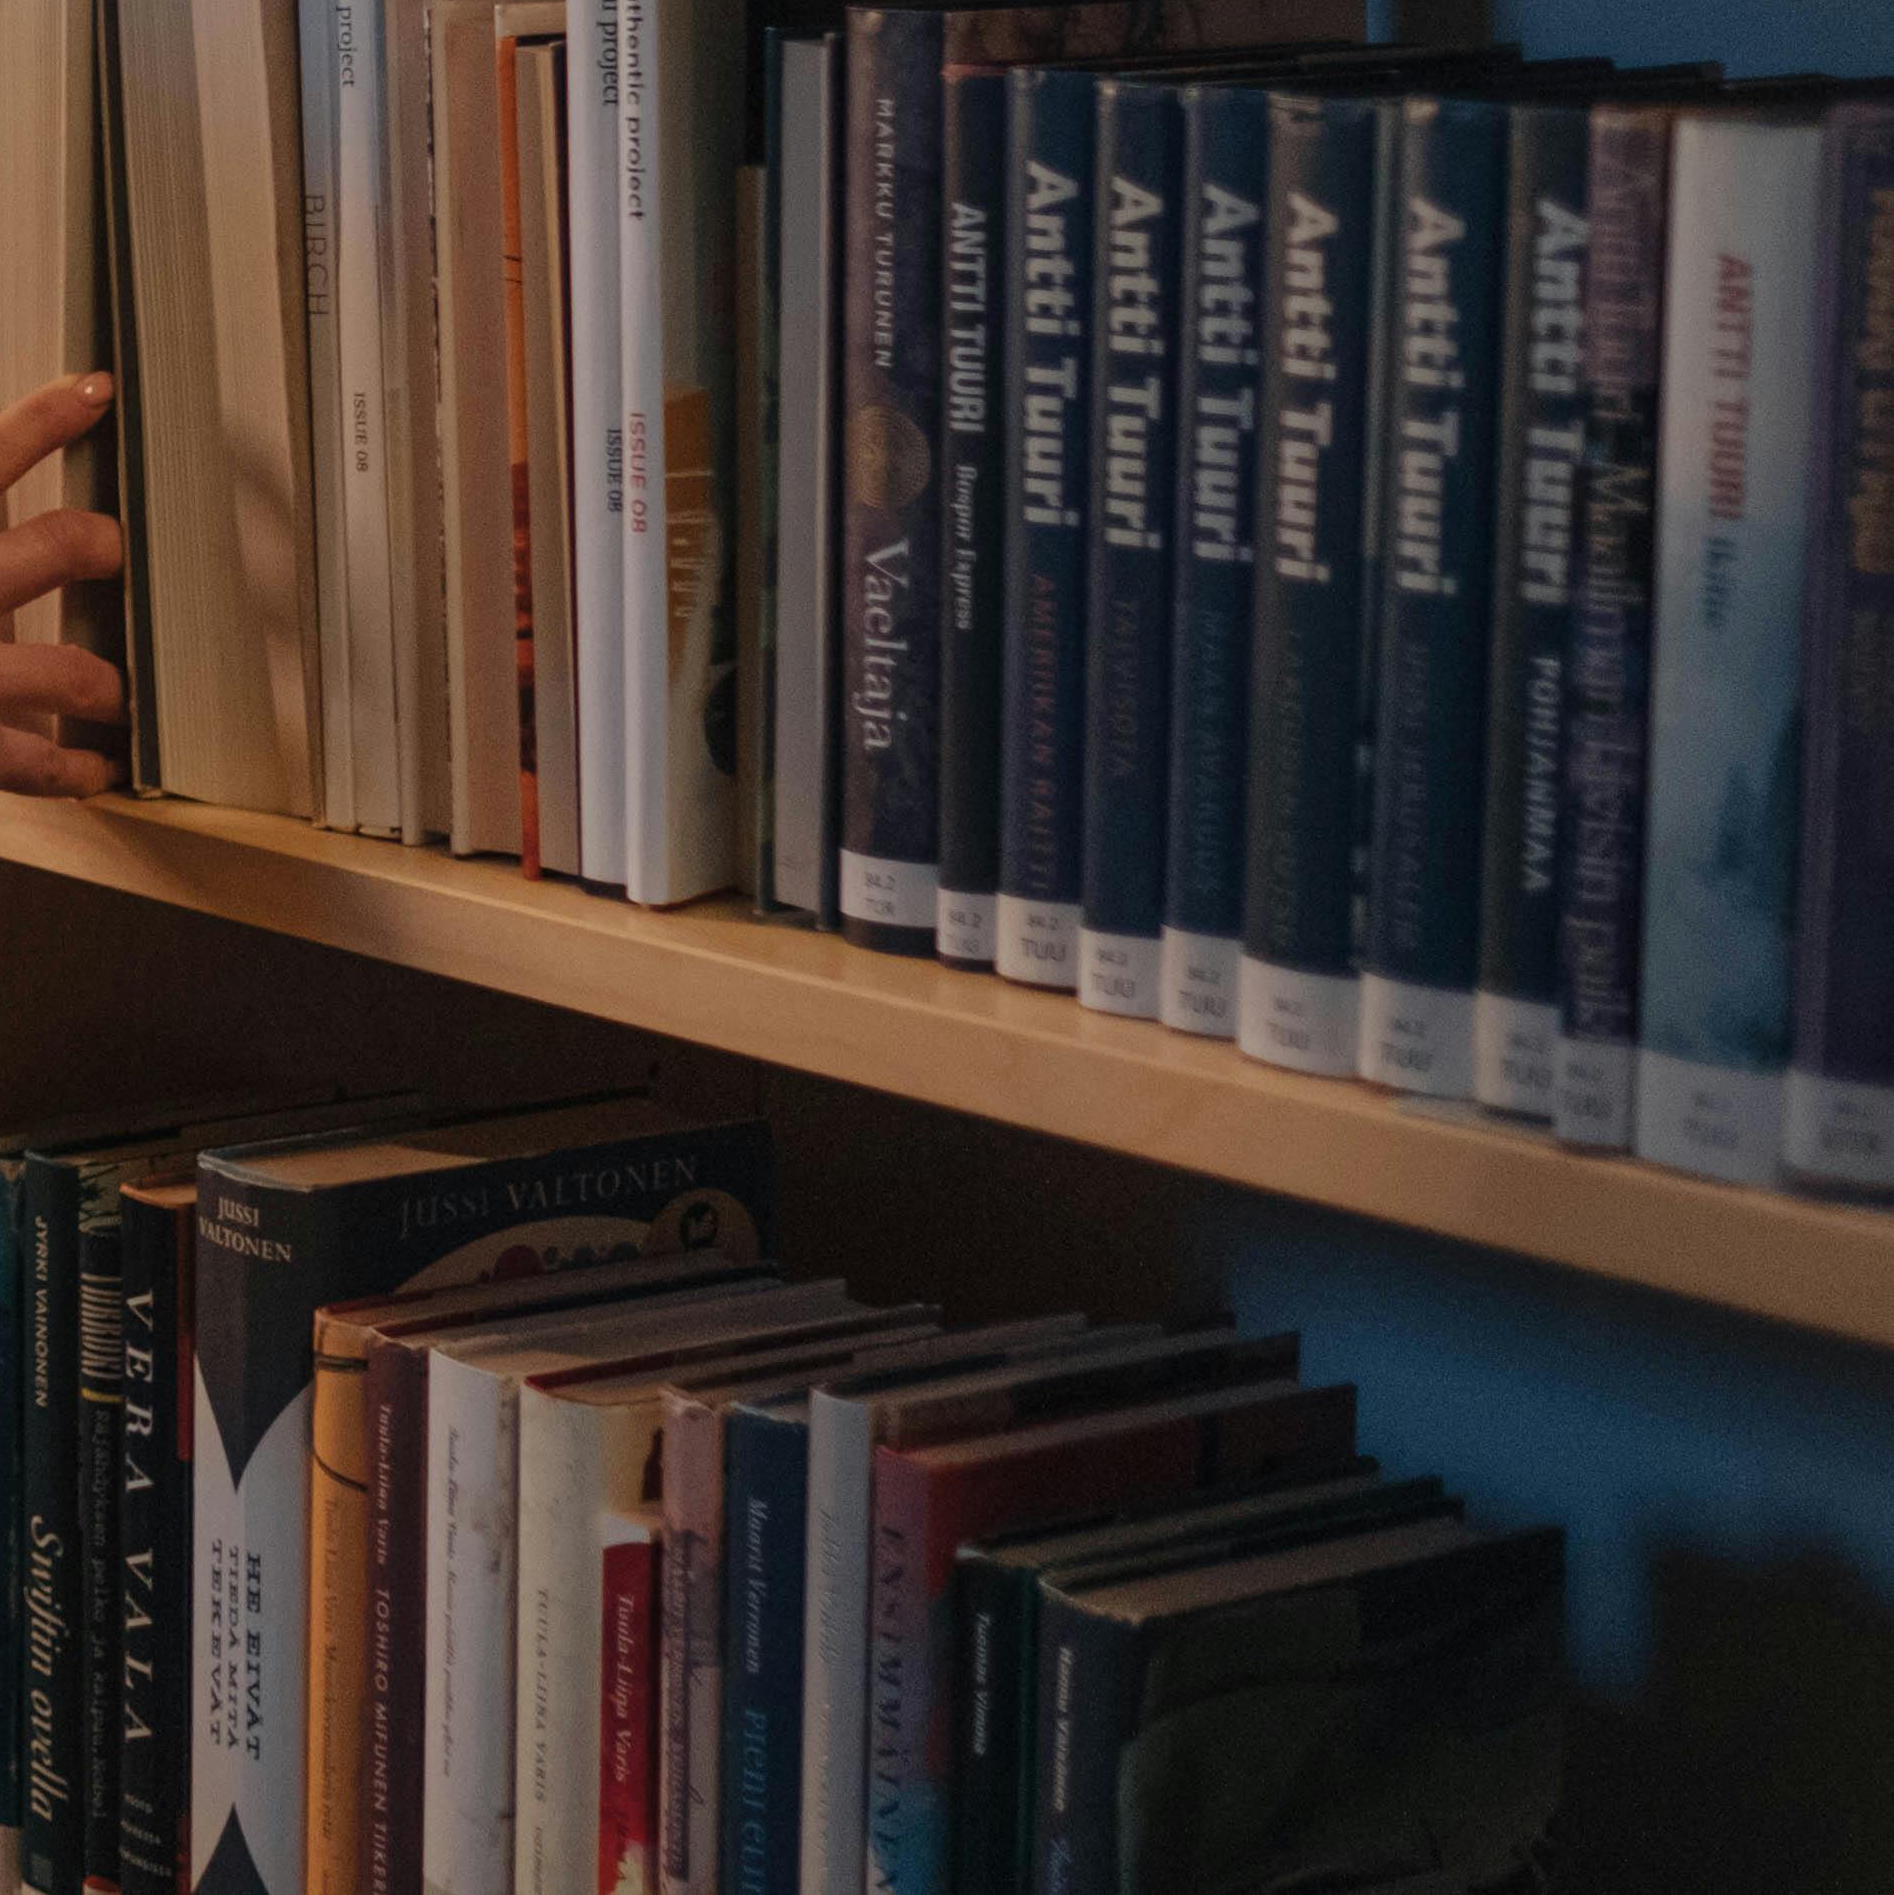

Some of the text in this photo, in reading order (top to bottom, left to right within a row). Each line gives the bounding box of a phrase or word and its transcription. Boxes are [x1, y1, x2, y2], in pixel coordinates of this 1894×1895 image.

[332, 4, 358, 88] project
[596, 20, 622, 107] project
[302, 192, 330, 319] BIRCH
[621, 115, 648, 221] project
[873, 98, 897, 368] MARKKU TURUNEN
[950, 202, 987, 433] ANTTI TUURI
[1023, 160, 1080, 527] Antti Tuuri
[1105, 177, 1166, 550] Antti Tuuri
[1194, 183, 1261, 561] Antti Tuuri
[1275, 205, 1336, 582] Antti Tuuri
[1396, 205, 1466, 596] Antti Tuuri
[1518, 205, 1593, 604] Antti Tuuri
[1709, 252, 1753, 522] ANTTI TUURI
[352, 391, 369, 473] ISSUE 08
[605, 427, 624, 513] ISSUE 08
[629, 412, 648, 532] ISSUE 08
[852, 536, 910, 751] Vaeltaja
[951, 548, 978, 631] Express
[1521, 658, 1564, 891] POHJANMAA
[1020, 935, 1067, 964] TUU
[197, 1215, 292, 1263] VALTONEN
[216, 1196, 260, 1226] JUSSI
[398, 1156, 699, 1240] JUSSI VALTONEN
[33, 1215, 52, 1407] JYRKI VAINONEN
[90, 1558, 111, 1622] pelko
[124, 1287, 155, 1744] VERA VALA
[374, 1517, 391, 1566] Varis
[744, 1497, 768, 1676] Maarit Verronen
[22, 1515, 69, 1819] Swiftin ovella
[90, 1632, 111, 1658] ja
[210, 1537, 224, 1746] TEKEVÄT
[227, 1545, 241, 1751] TIEDÄ MITÄ
[245, 1551, 263, 1762] HE EIVÄT
[372, 1587, 391, 1693] TOSHIRO
[534, 1588, 549, 1802] TUULA-LIINA VARIS
[613, 1593, 635, 1782] Tuula-Liina Varis
[973, 1612, 992, 1756] Tuomas Vimma
[372, 1701, 390, 1812] MIFUNEN
